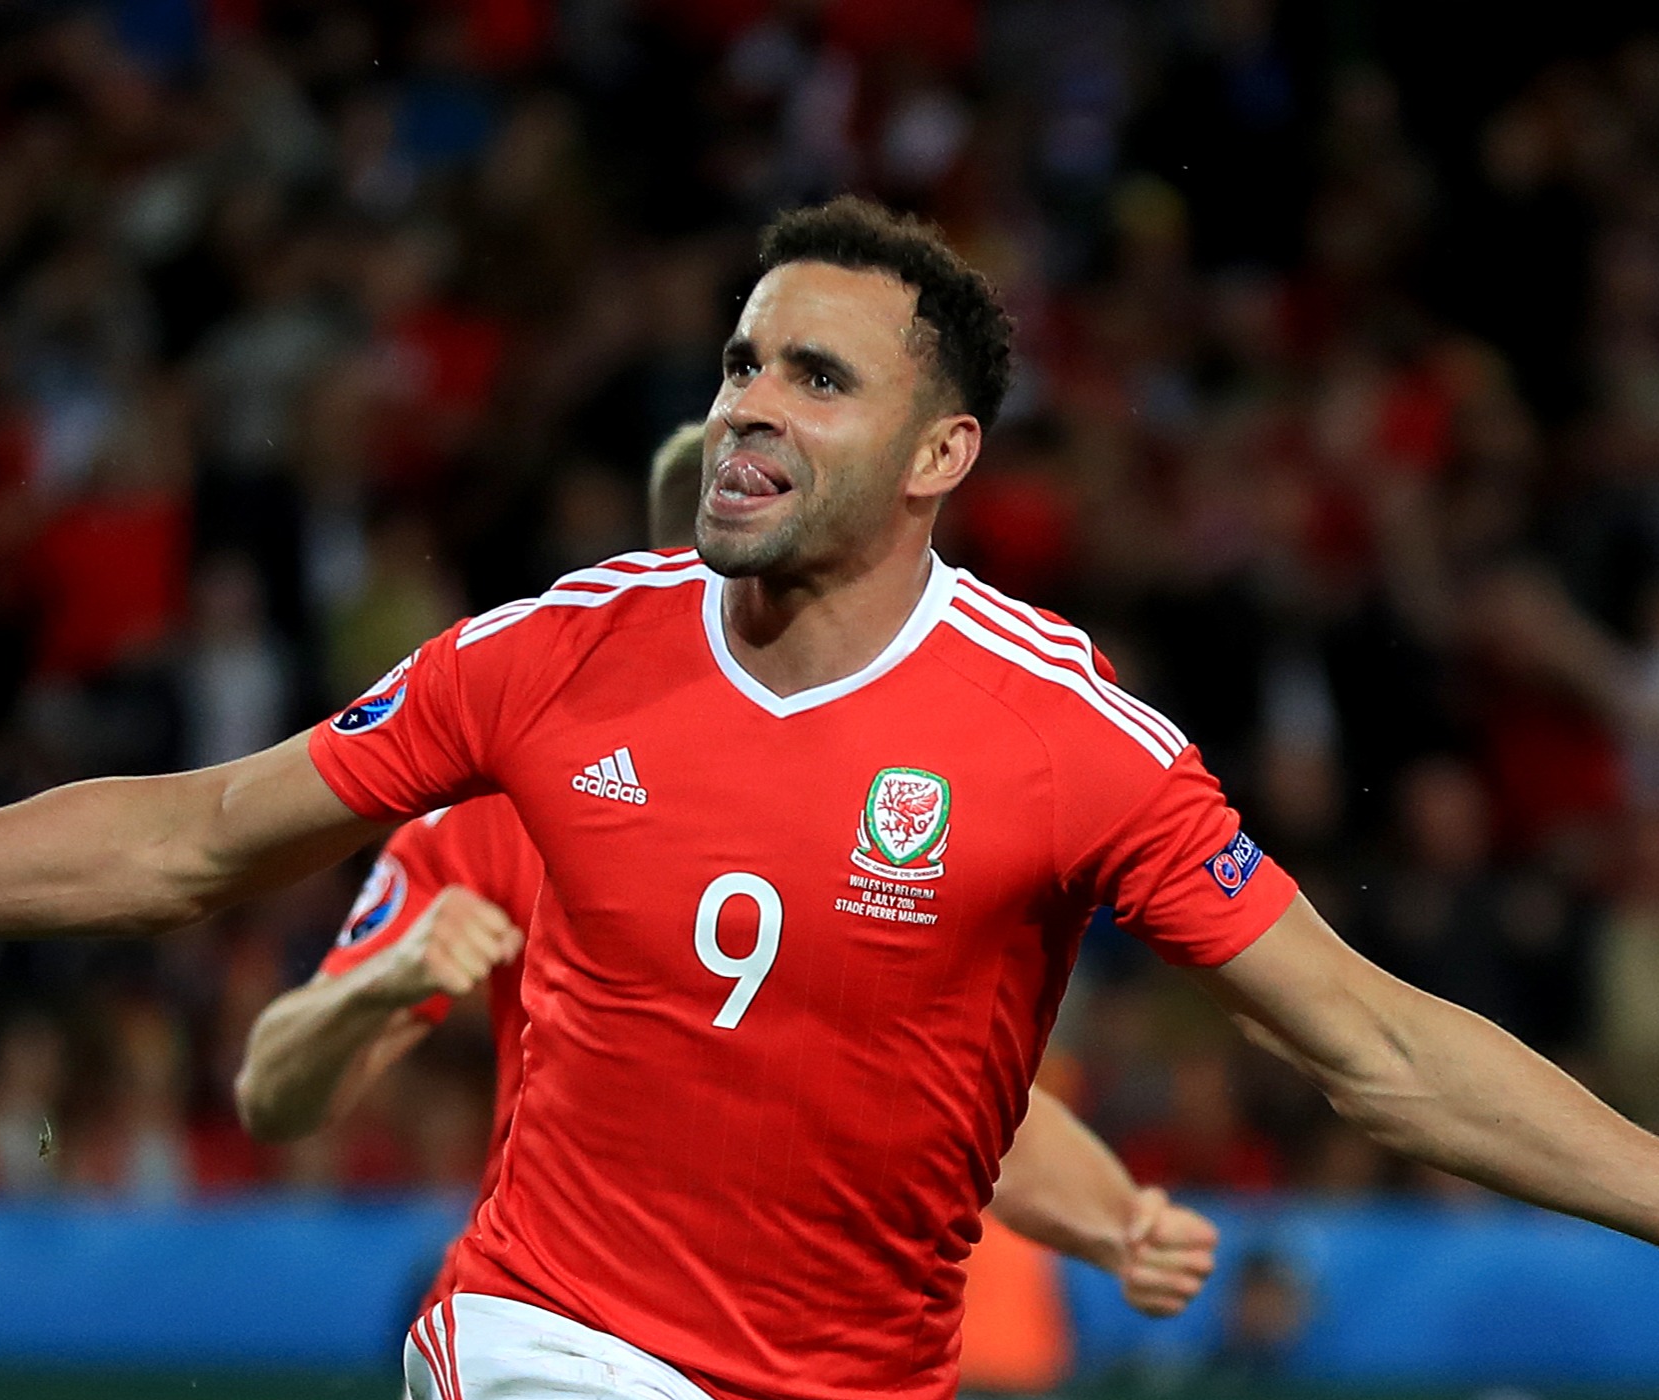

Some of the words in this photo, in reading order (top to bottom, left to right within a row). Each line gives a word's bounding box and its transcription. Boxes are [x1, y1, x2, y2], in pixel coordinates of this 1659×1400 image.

[572, 775, 647, 805] adidas
[849, 874, 881, 892] WALES
[882, 882, 893, 893] VS
[894, 884, 935, 900] BELGIUM
[872, 892, 896, 907] JULY
[834, 898, 866, 916] STADE
[866, 903, 898, 921] PIERRE
[898, 910, 938, 925] MAUROY
[694, 872, 783, 1029] 9
